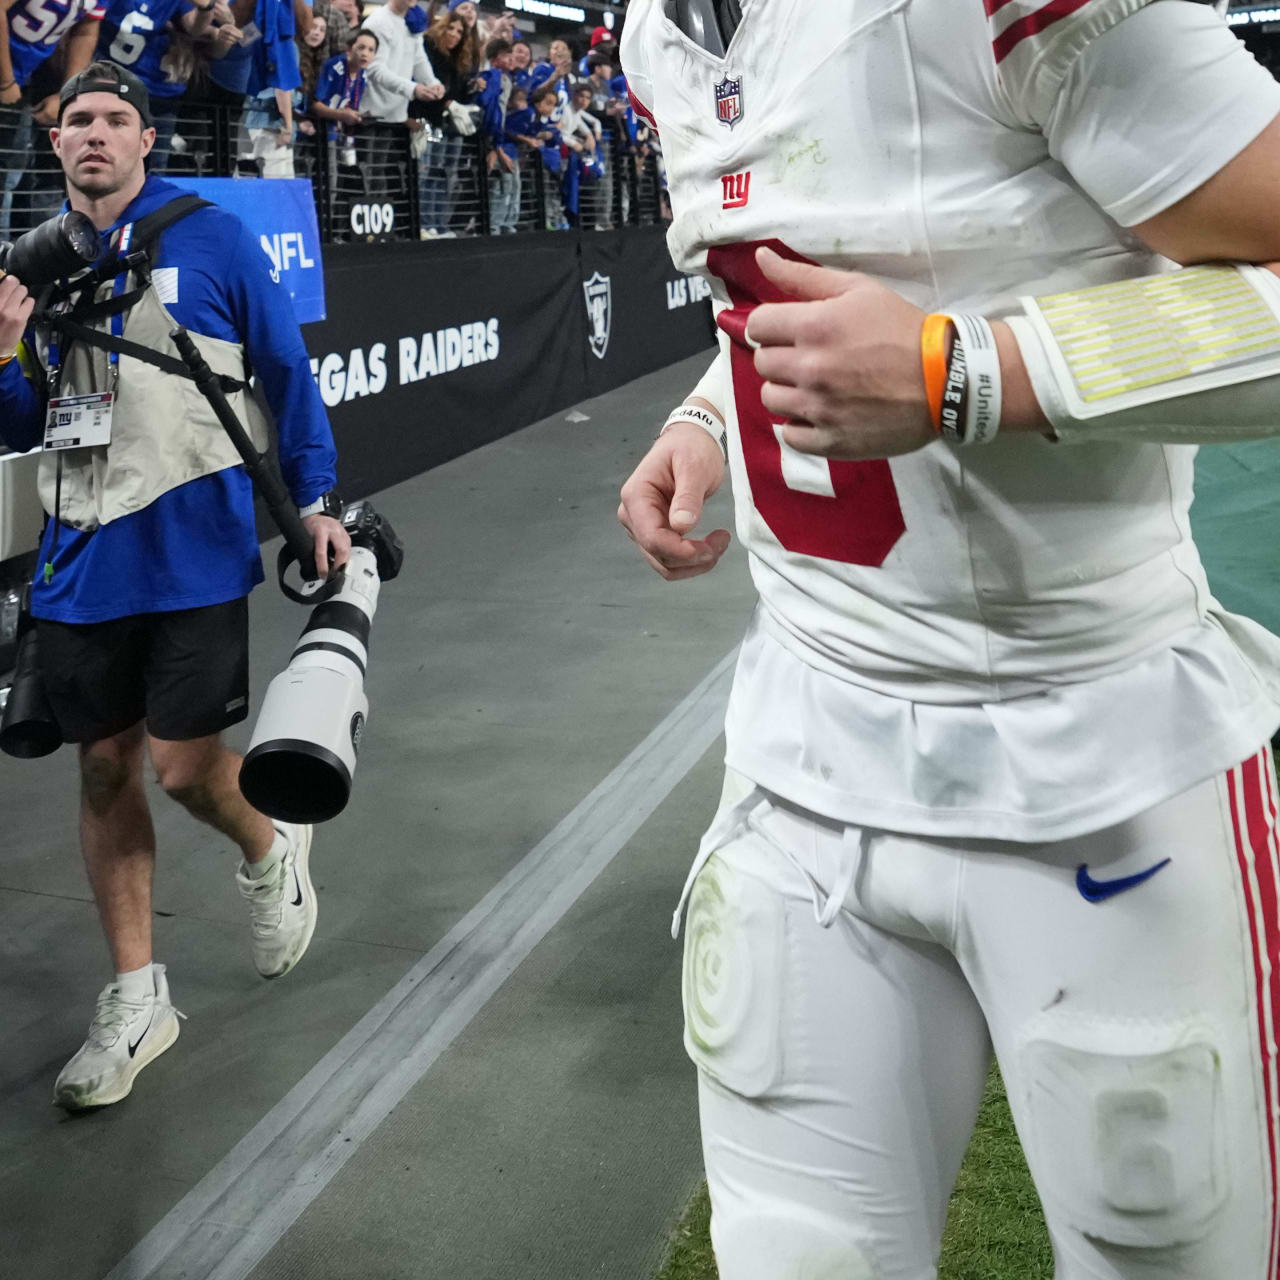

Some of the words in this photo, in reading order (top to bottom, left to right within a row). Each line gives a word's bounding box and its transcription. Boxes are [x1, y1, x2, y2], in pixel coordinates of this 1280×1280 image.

[109, 11, 154, 65] 6
[718, 96, 739, 120] NFL
[351, 203, 394, 235] C109
[260, 232, 315, 272] NFL
[666, 278, 687, 310] LAS
[310, 342, 387, 408] GAS
[398, 317, 500, 386] RAIDERS
